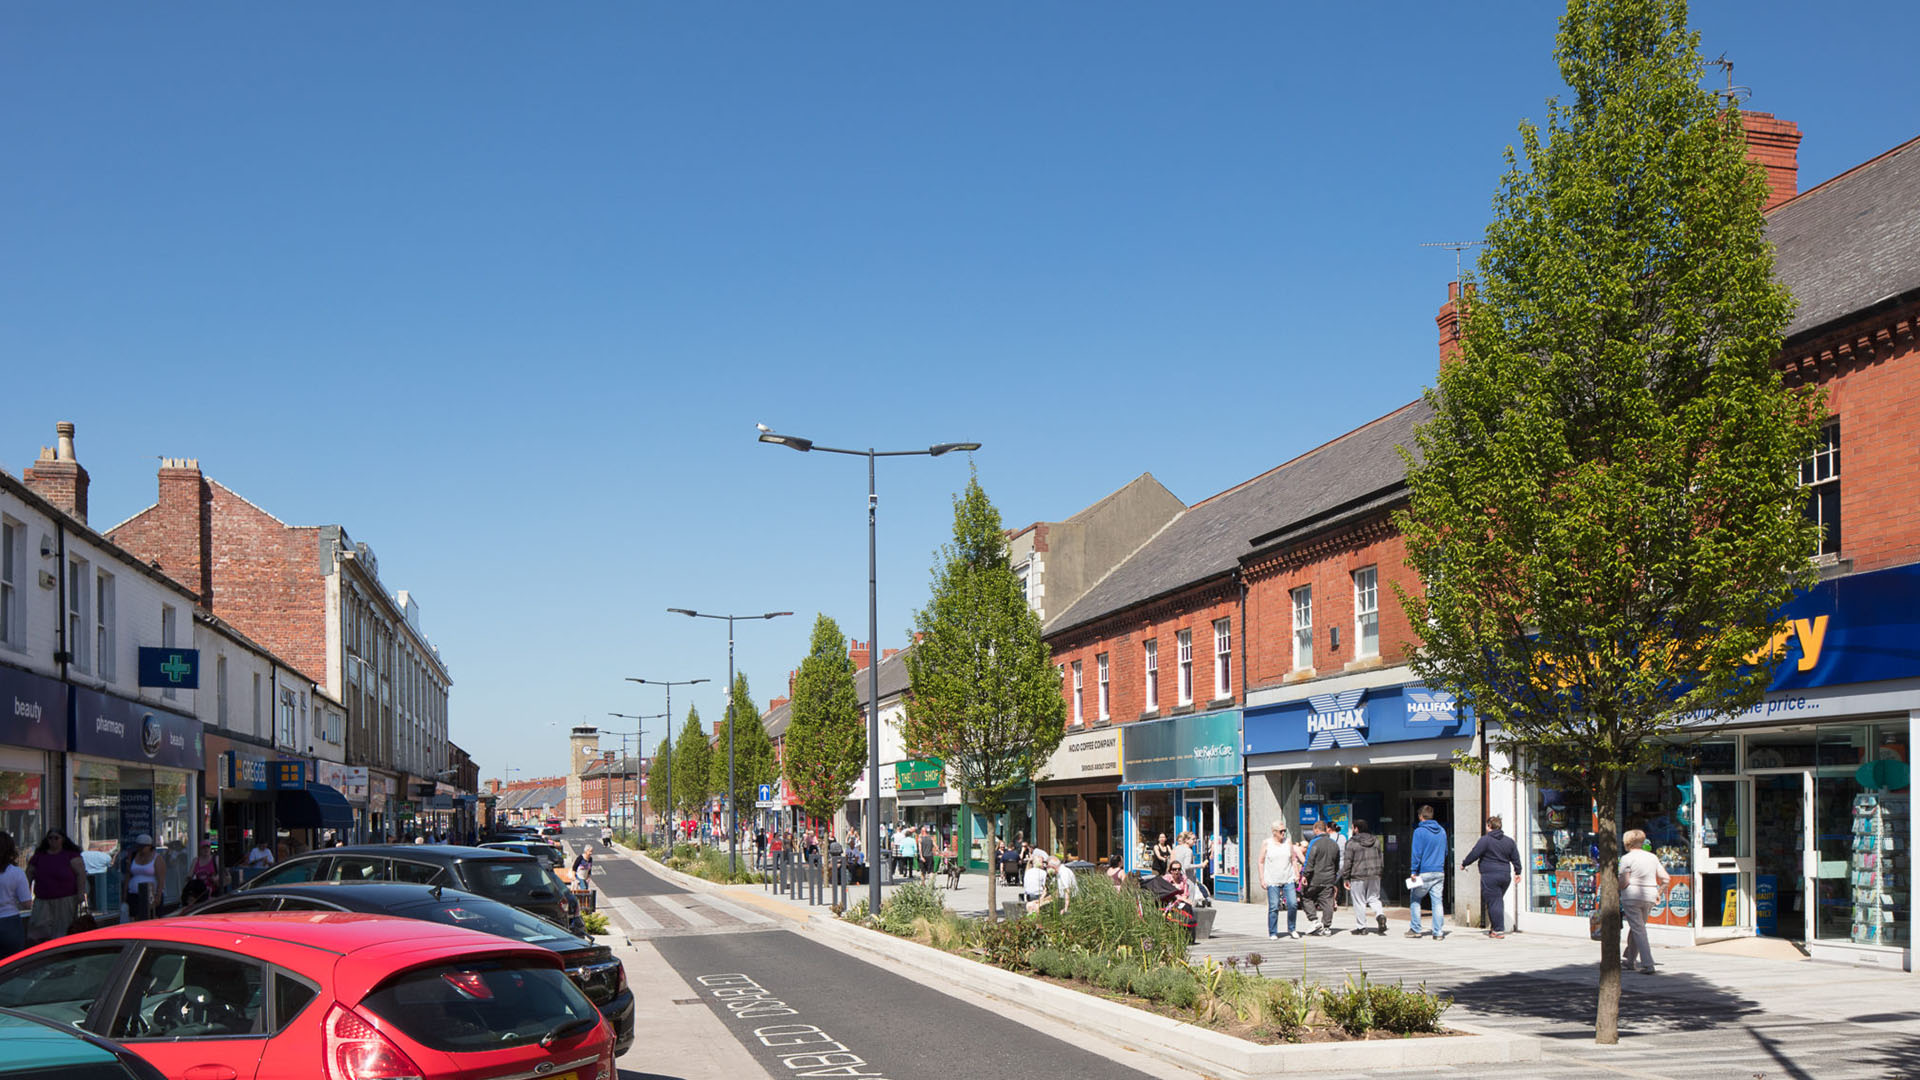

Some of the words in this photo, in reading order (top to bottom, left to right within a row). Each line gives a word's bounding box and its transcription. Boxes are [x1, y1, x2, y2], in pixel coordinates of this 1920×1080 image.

[14, 696, 42, 723] beauty
[1407, 701, 1457, 712] HALIFAX
[96, 715, 125, 738] pharmacy
[1307, 708, 1366, 733] HALIFAX
[170, 732, 185, 750] beauty
[1080, 741, 1094, 751] COFFEE
[1094, 738, 1116, 749] COMPANY
[242, 759, 266, 783] GREGGS
[901, 772, 911, 783] THE
[924, 769, 938, 781] SHOP
[697, 973, 799, 1019] DISABLED
